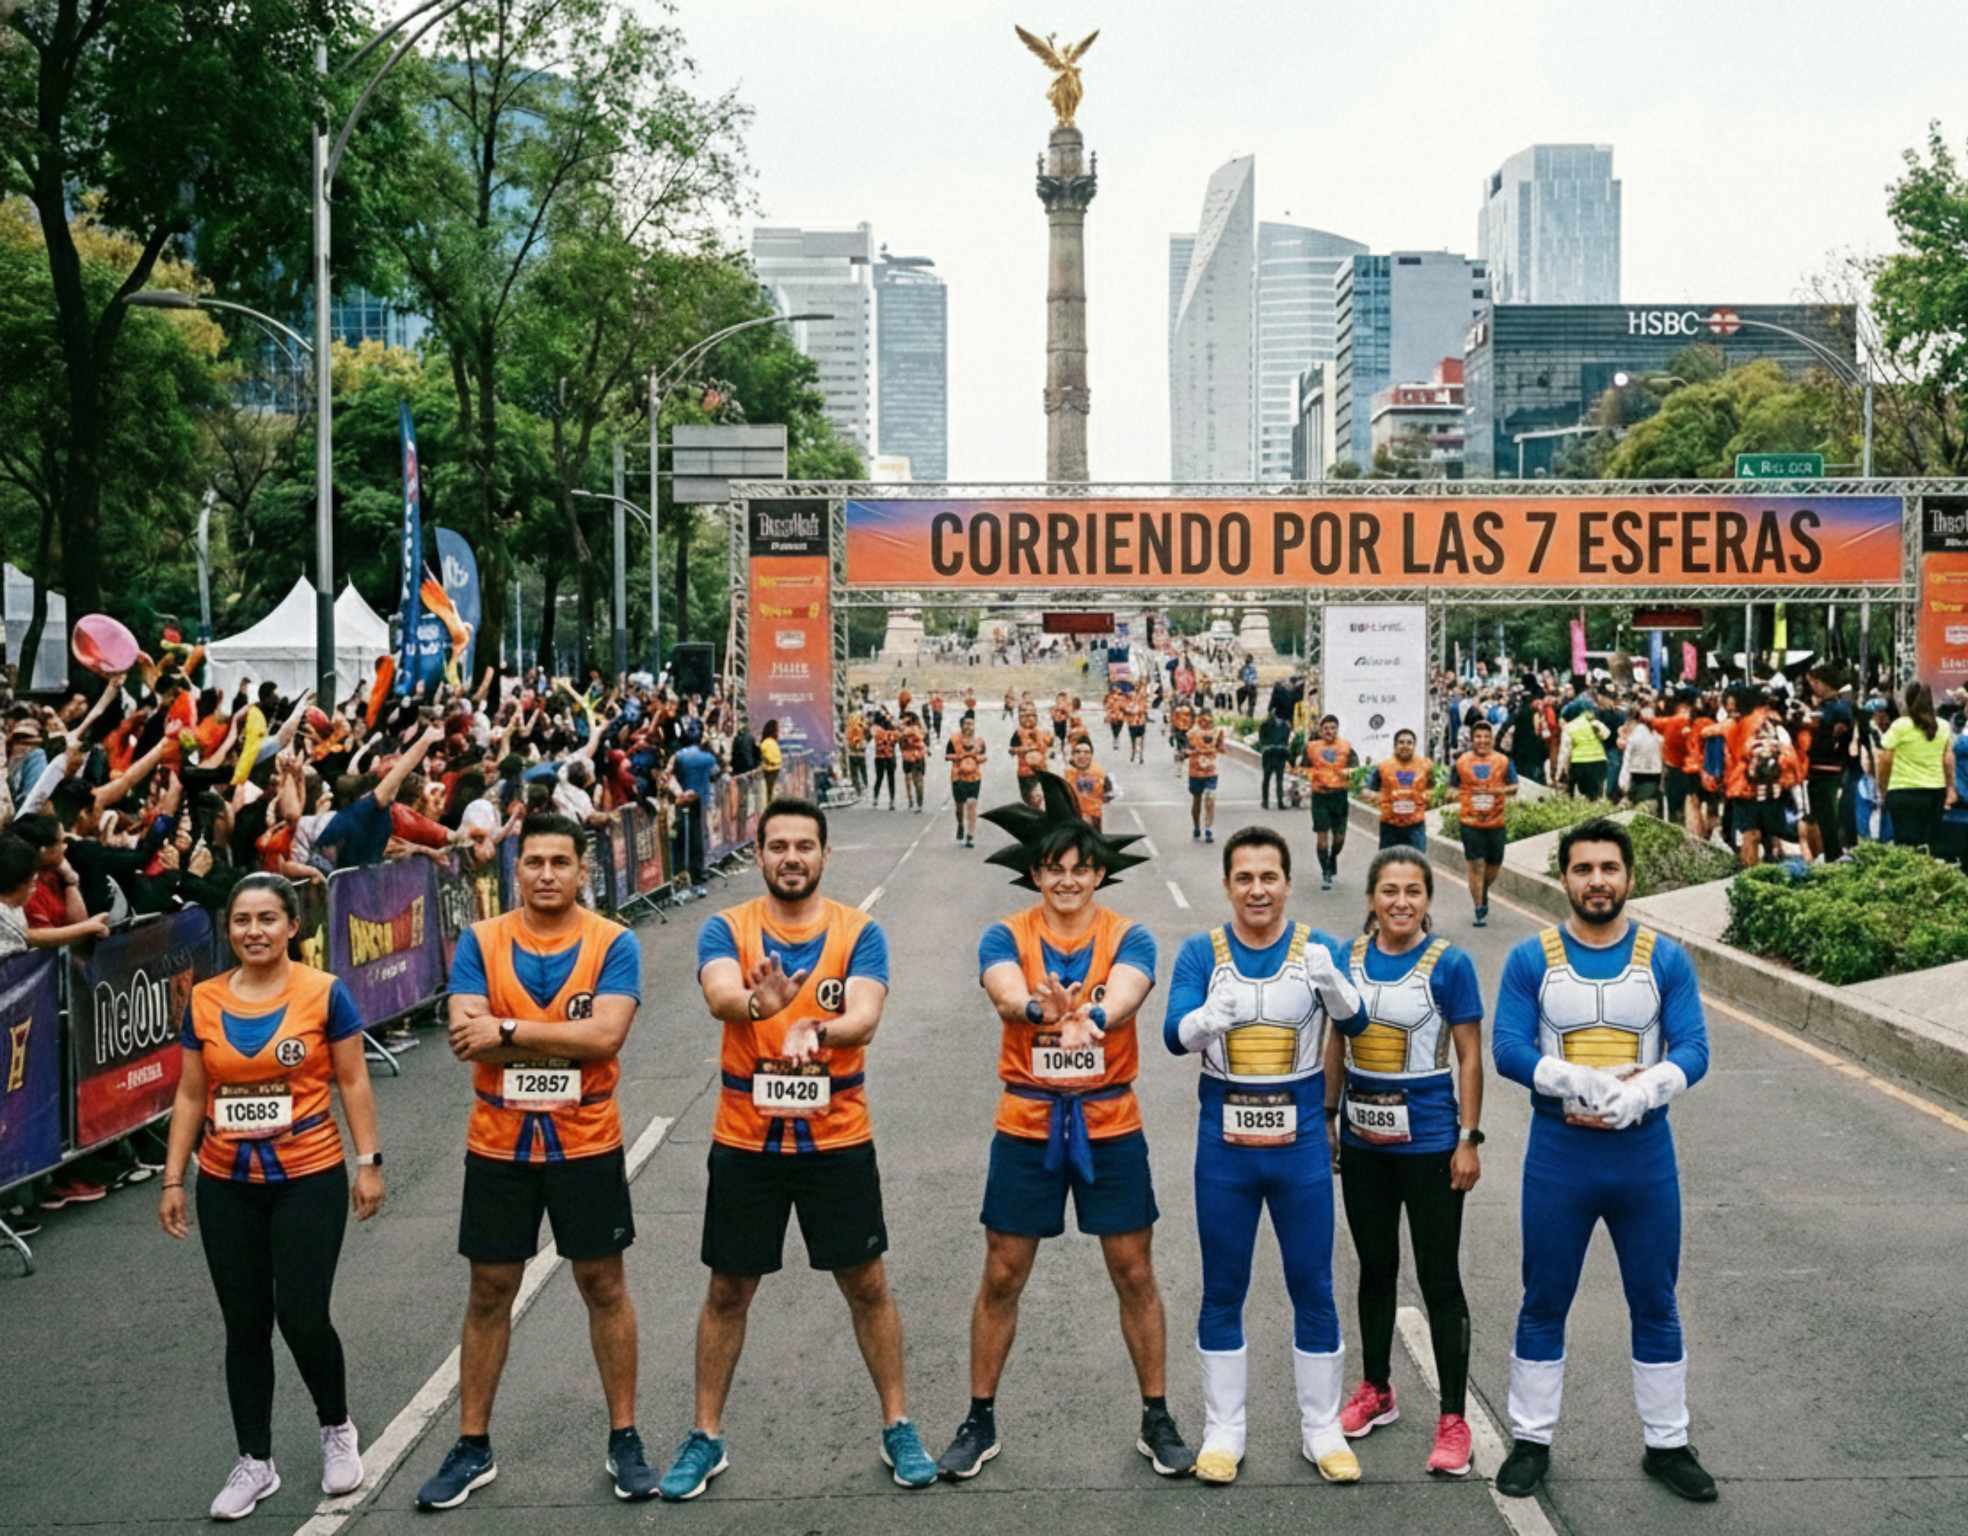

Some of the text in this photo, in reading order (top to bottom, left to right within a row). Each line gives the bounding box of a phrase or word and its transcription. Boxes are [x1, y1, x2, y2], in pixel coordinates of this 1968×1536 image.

[1628, 311, 1700, 335] HSBC
[931, 510, 1822, 576] CORRIENDO POR LAS 7 ESFERAS
[515, 1075, 570, 1093] 12857
